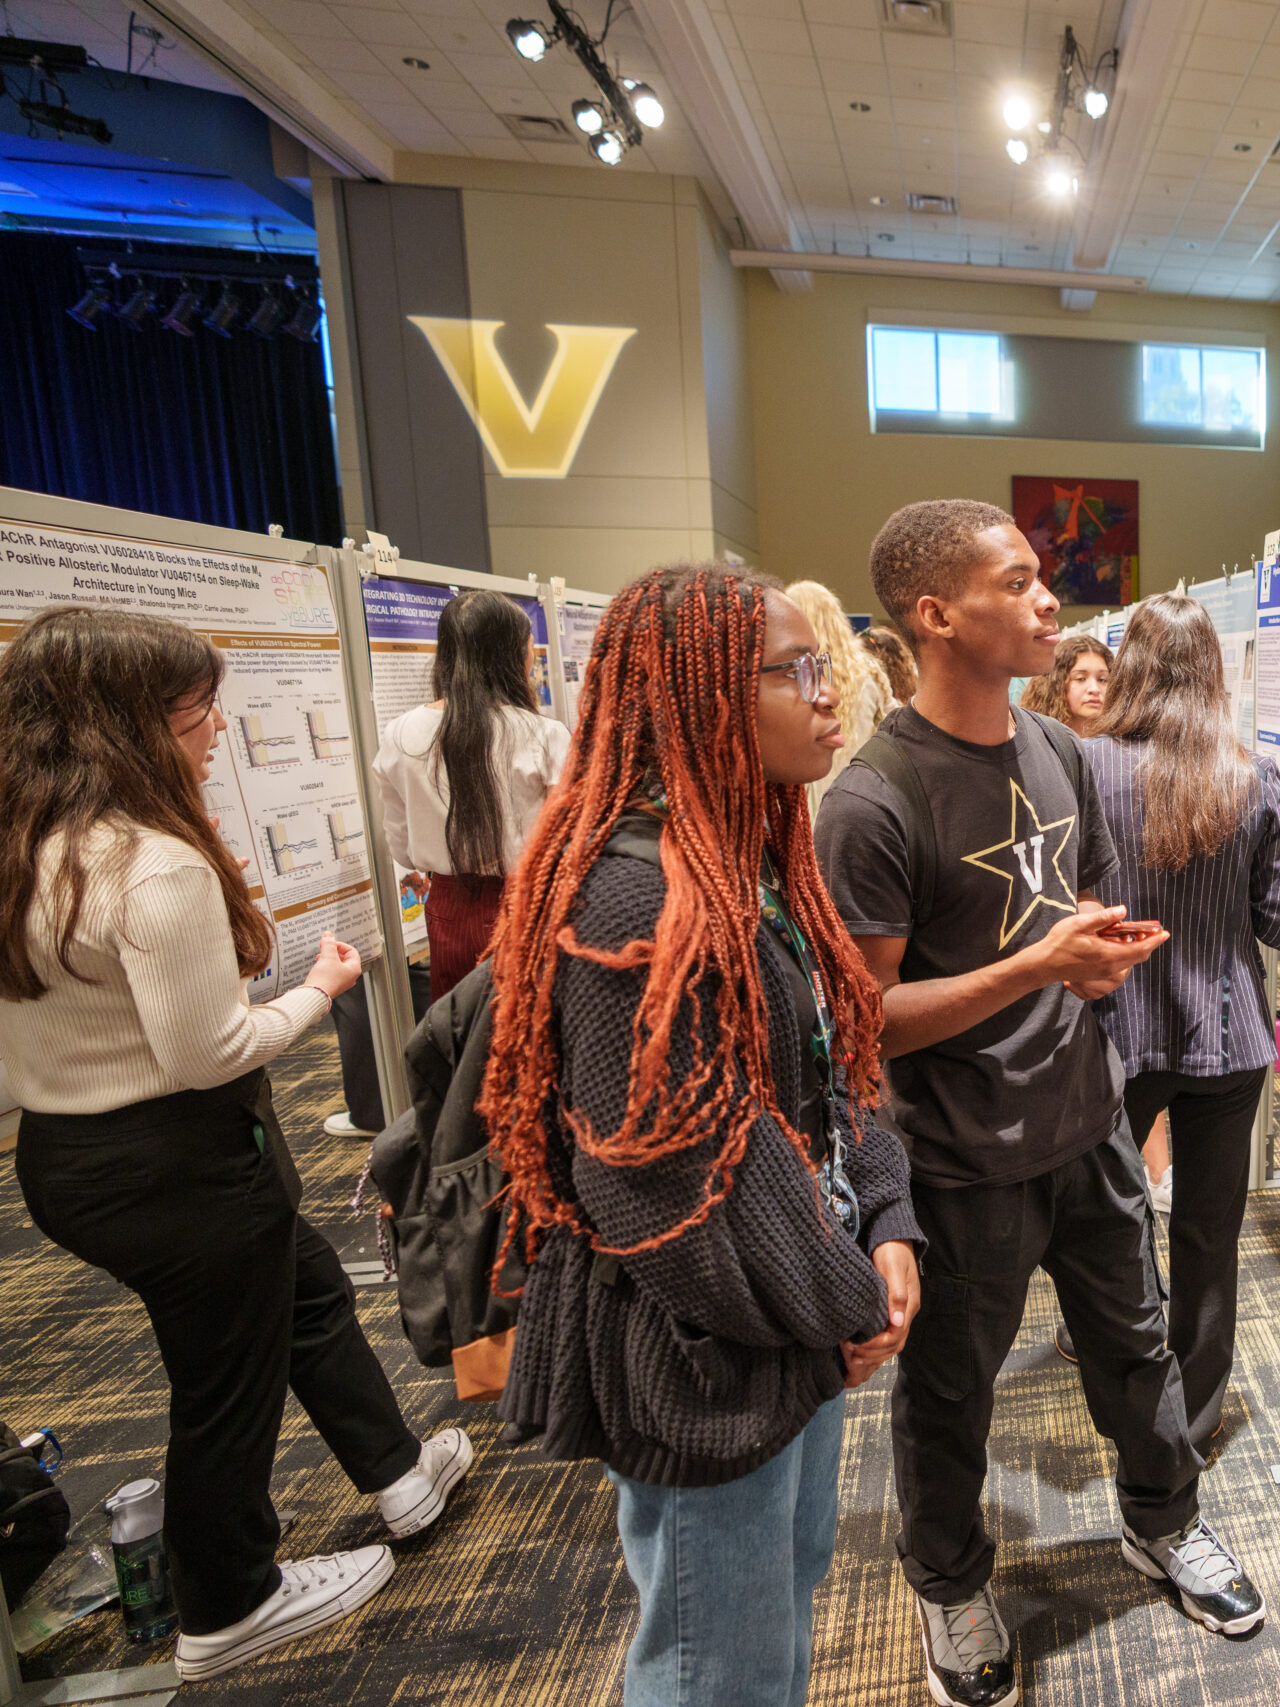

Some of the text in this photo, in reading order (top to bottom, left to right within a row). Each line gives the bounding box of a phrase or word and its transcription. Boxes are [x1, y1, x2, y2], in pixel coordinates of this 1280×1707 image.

[406, 315, 638, 479] V
[6, 550, 56, 567] Positive
[58, 556, 110, 573] Allosteric
[111, 562, 159, 579] Modulator
[160, 568, 207, 584] VU0467154
[208, 576, 218, 586] on
[219, 576, 260, 590] Sleep-Wake
[39, 535, 100, 554] Antagonist
[101, 543, 156, 562] VU6028418
[156, 551, 187, 566] Blocks
[188, 556, 201, 567] the
[202, 557, 230, 571] Effects
[231, 561, 239, 572] of
[240, 562, 251, 574] the
[377, 548, 393, 564] 114
[49, 591, 71, 600] Jason
[73, 576, 197, 600] Architecture in Young Mice
[1012, 833, 1045, 894] V
